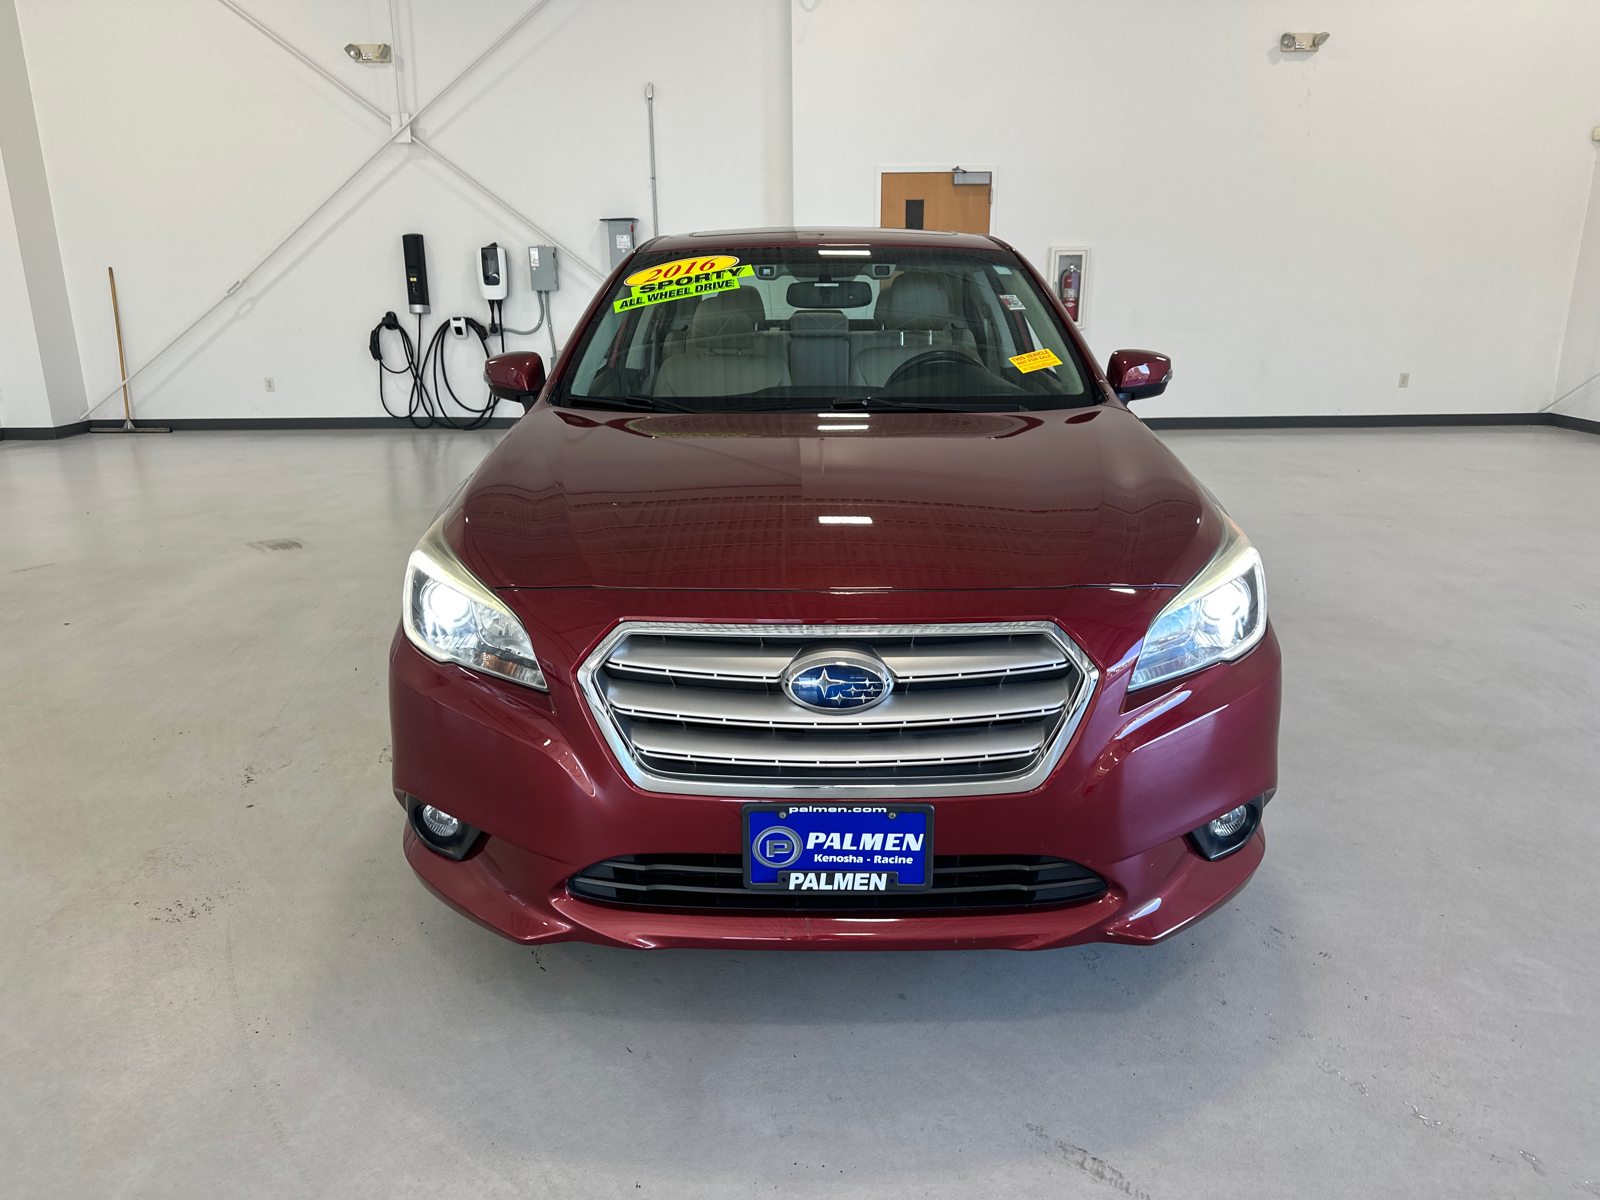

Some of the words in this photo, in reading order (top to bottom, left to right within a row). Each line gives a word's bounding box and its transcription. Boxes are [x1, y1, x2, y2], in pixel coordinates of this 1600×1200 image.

[639, 267, 745, 294] SPORTY
[643, 258, 720, 284] 2016
[619, 297, 645, 310] ALL
[647, 287, 693, 302] WHEEL
[695, 279, 735, 294] DRIVE
[1026, 350, 1049, 358] VEHICLE
[788, 805, 887, 814] palmen.com
[806, 832, 924, 851] PALMEN
[814, 853, 864, 864] Kenosha
[873, 855, 914, 864] Racine
[788, 872, 888, 891] PALMEN
